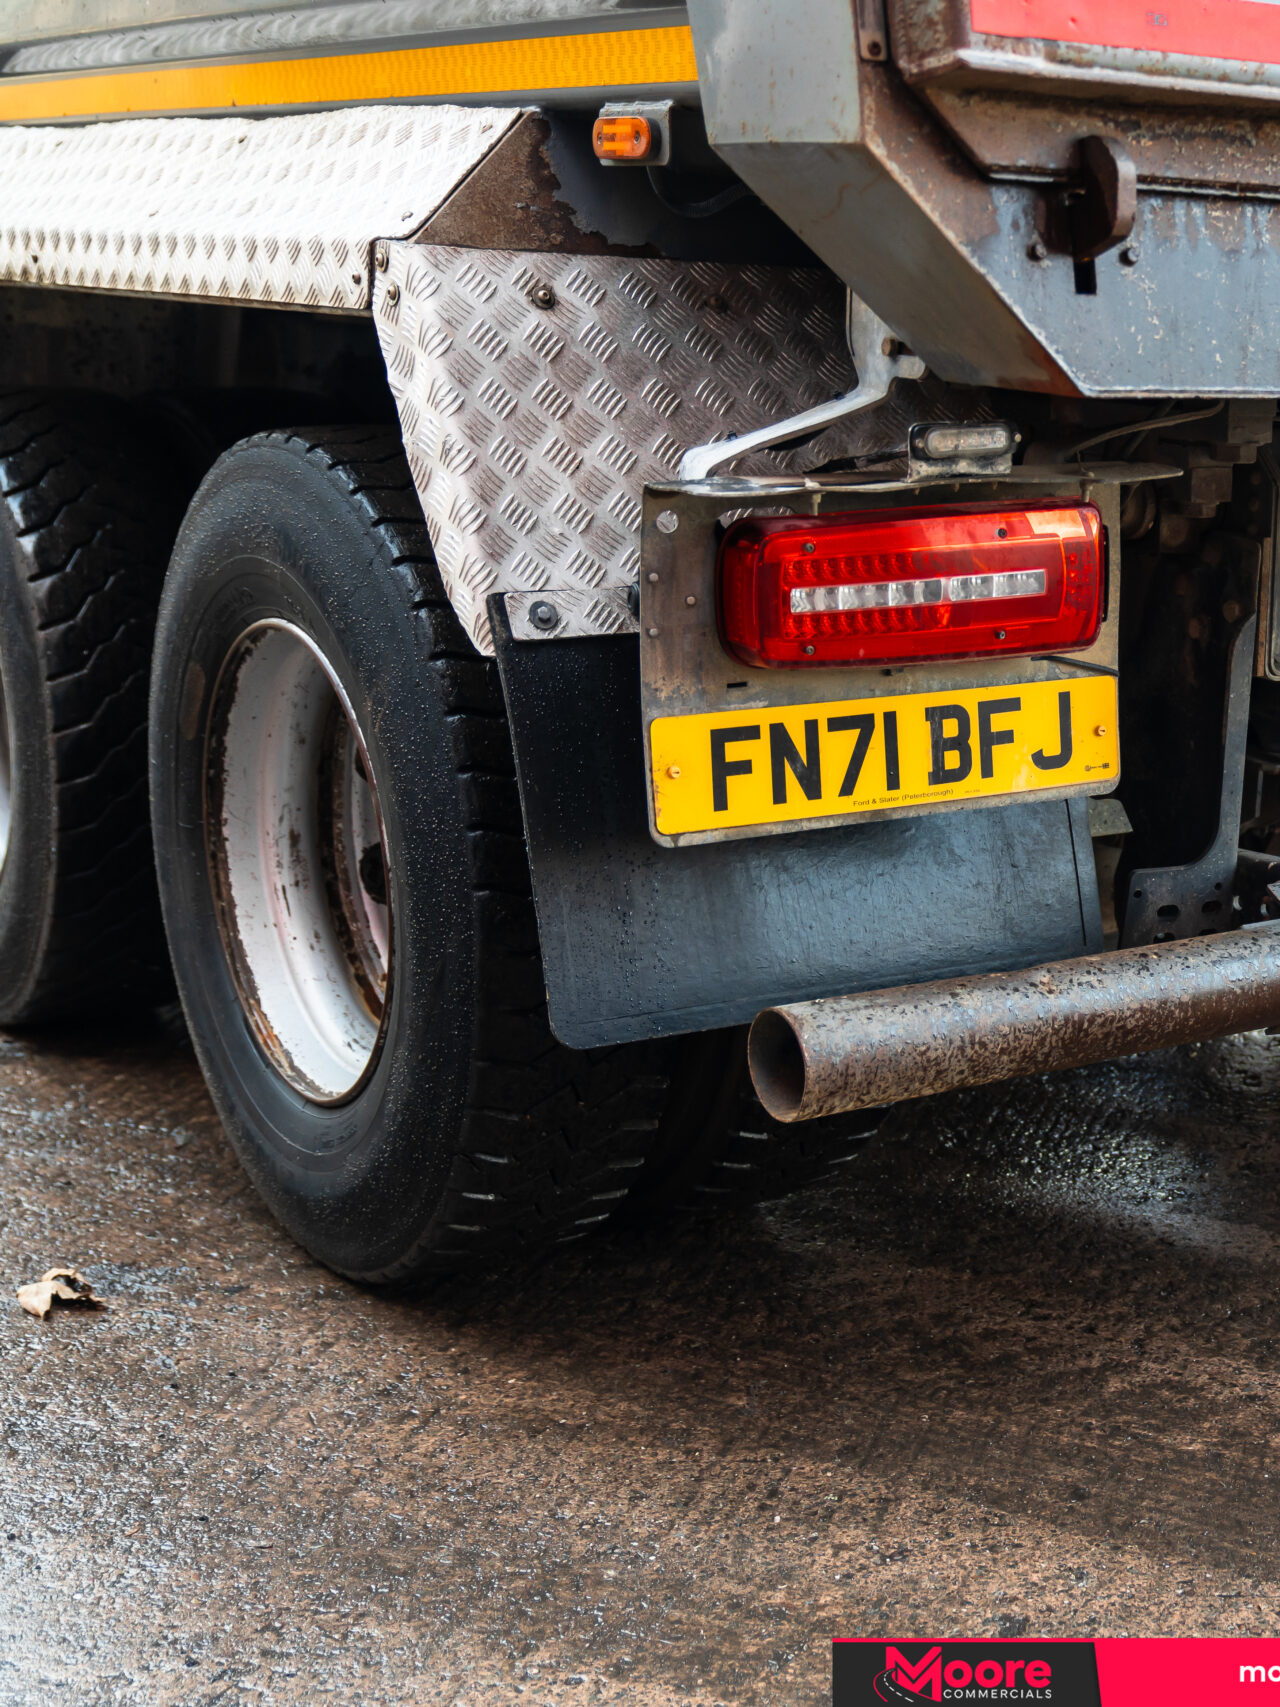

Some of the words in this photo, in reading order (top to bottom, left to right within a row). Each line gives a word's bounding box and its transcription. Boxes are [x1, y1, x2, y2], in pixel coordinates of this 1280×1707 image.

[709, 710, 901, 812] FN71
[924, 691, 1073, 786] BFJ
[853, 799, 870, 807] Ford
[879, 795, 900, 803] Slater
[901, 788, 954, 802] (Peterborough)
